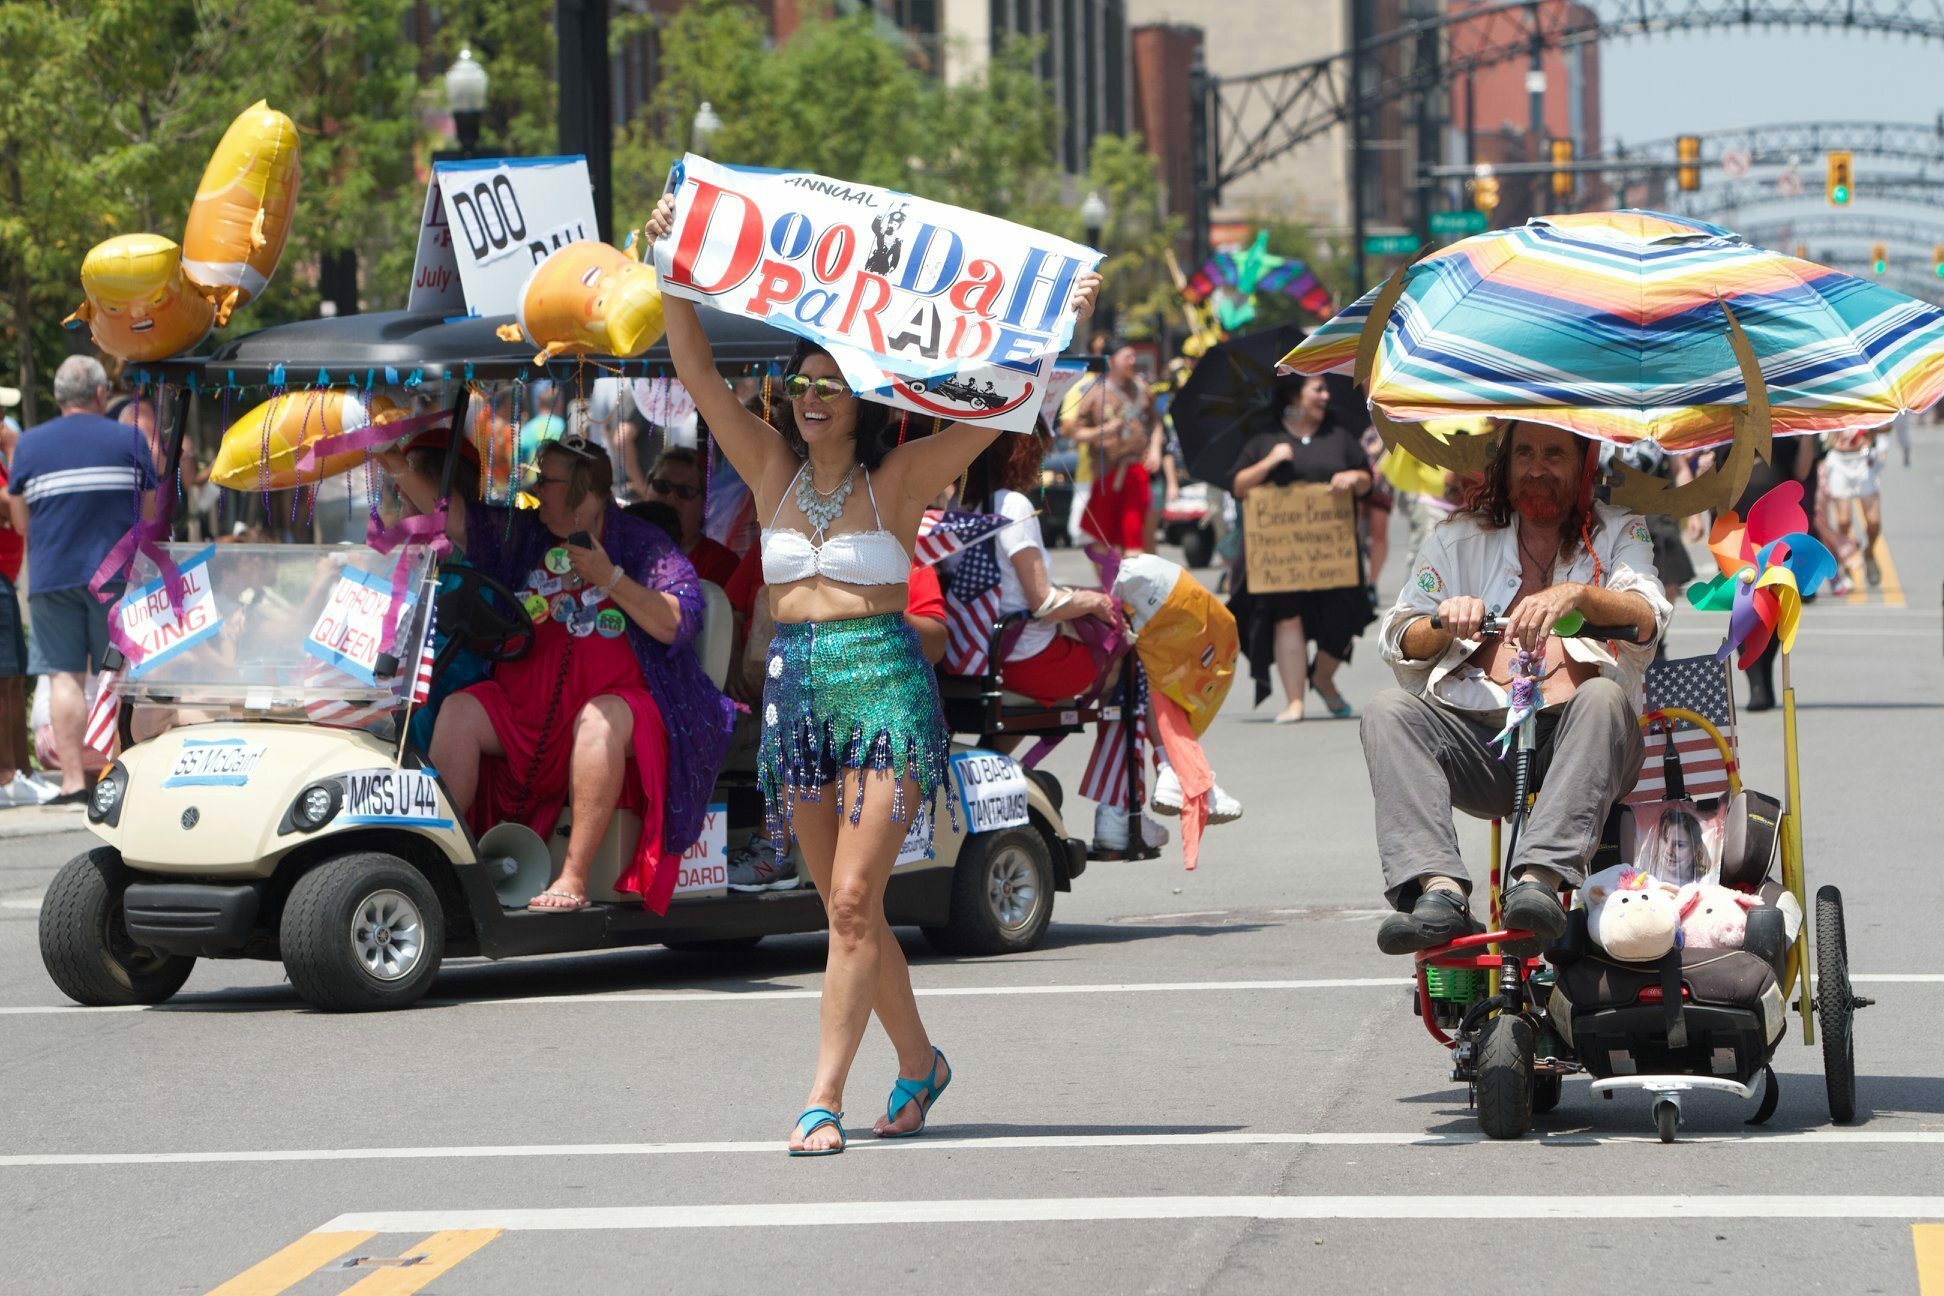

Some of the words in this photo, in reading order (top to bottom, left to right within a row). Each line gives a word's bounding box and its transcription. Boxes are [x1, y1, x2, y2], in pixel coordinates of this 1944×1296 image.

[784, 176, 879, 208] ANNUAL
[451, 174, 527, 261] DOO
[416, 265, 452, 293] July
[126, 572, 201, 628] UnROAL
[335, 582, 391, 618] UnROY
[314, 616, 377, 663] QUEEN
[959, 760, 982, 787] NO
[981, 757, 1018, 783] BABY
[350, 775, 395, 815] MISS
[399, 775, 410, 815] U
[415, 775, 436, 816] 44
[677, 865, 726, 887] OARD
